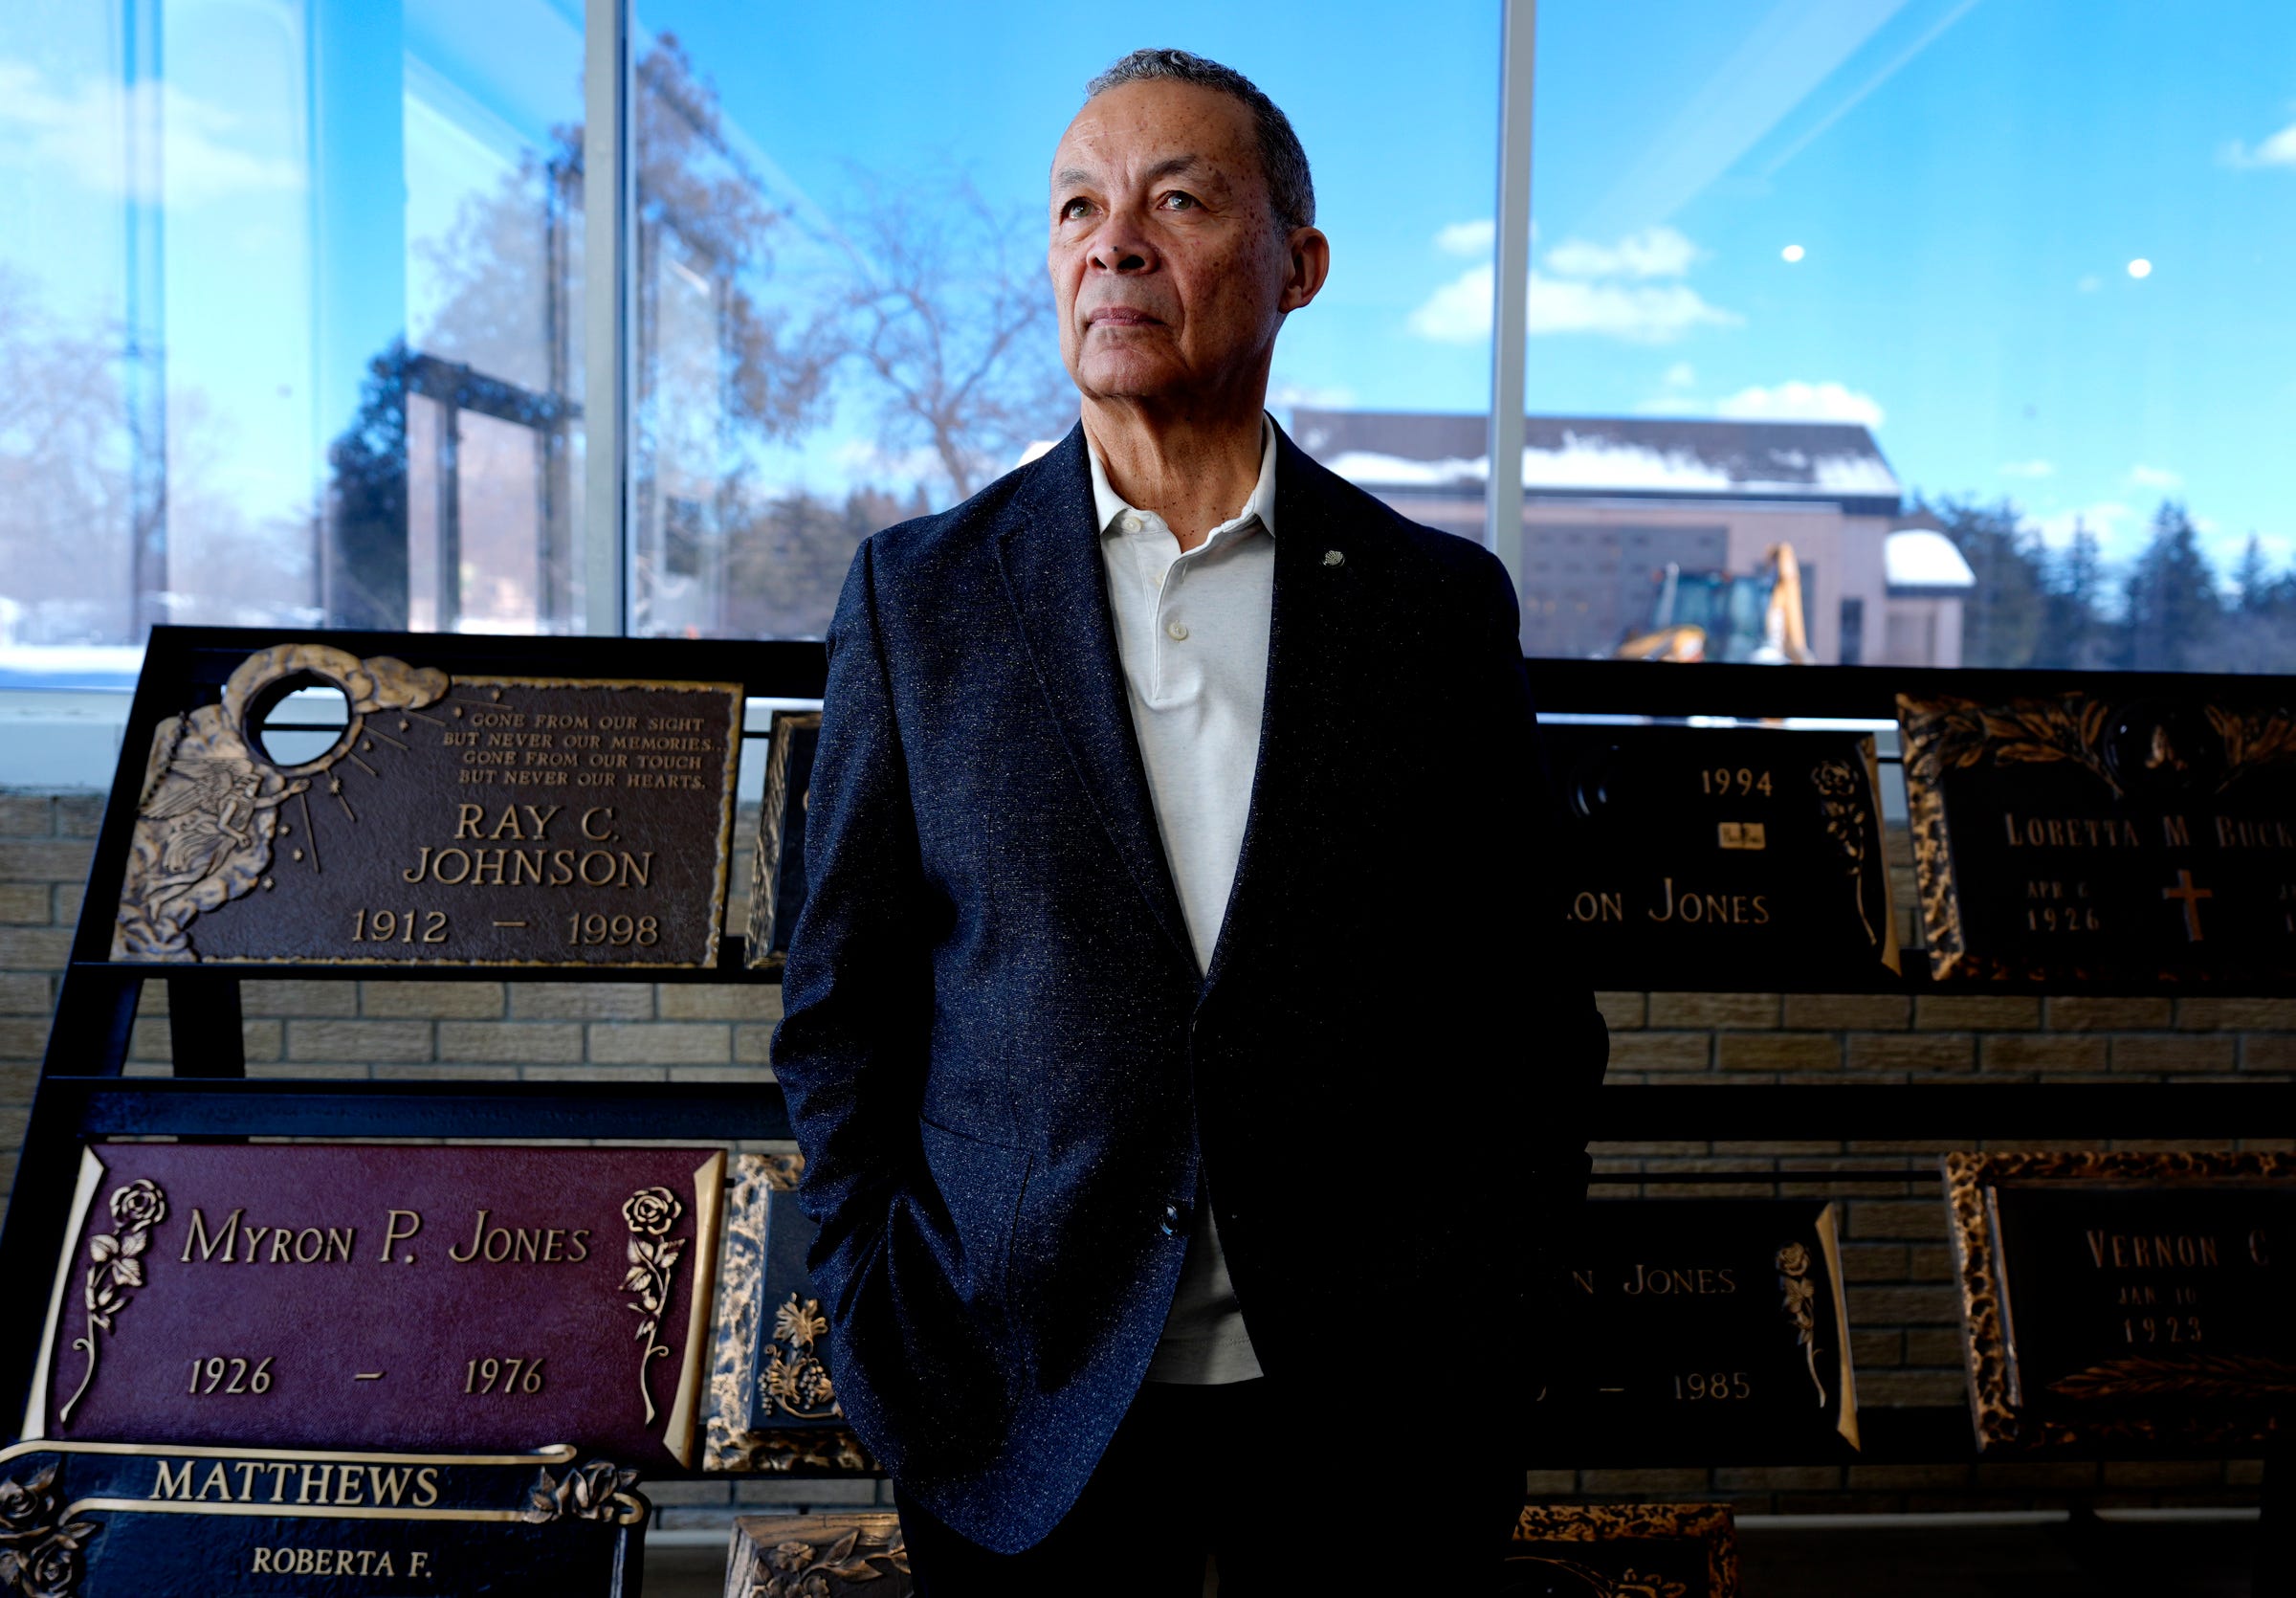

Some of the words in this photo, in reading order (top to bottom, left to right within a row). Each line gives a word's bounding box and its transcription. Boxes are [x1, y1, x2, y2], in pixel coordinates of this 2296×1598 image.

[471, 713, 526, 728] GONE
[535, 714, 589, 730] FROM
[598, 717, 639, 730] OUR
[649, 717, 705, 732] SIGHT
[444, 732, 479, 746] BUT
[487, 732, 554, 748] NEVER
[563, 734, 603, 749] OUR
[462, 750, 517, 765] GONE
[527, 751, 580, 766] FROM
[589, 753, 629, 768] OUR
[639, 754, 703, 770] TOUCH
[458, 769, 497, 784] BUT
[503, 770, 569, 787] NEVER
[577, 772, 618, 788] OUR
[627, 773, 708, 789] HEARTS.
[1701, 766, 1774, 798] 1994
[453, 804, 565, 841] RAY
[581, 806, 621, 842] C.
[2004, 811, 2141, 848] LORETTA
[2162, 814, 2190, 848] M
[403, 846, 656, 888] JOHNSON
[1565, 891, 1623, 922] ON
[1647, 877, 1771, 924] JONES
[352, 908, 450, 943] 1912
[568, 912, 660, 947] 1998
[2026, 907, 2101, 932] 1926
[180, 1208, 357, 1264] MYRON
[379, 1209, 424, 1265] P.
[448, 1209, 592, 1264] JONES
[2085, 1229, 2219, 1269] VERNON
[1623, 1264, 1737, 1295] JONES
[2123, 1316, 2203, 1344] 1923
[188, 1356, 276, 1395] 1926
[465, 1357, 546, 1396] 1976
[1673, 1372, 1752, 1400] 1985
[147, 1459, 440, 1508] MATTHEWS
[250, 1546, 395, 1577] ROBERTA
[408, 1551, 433, 1579] F.
